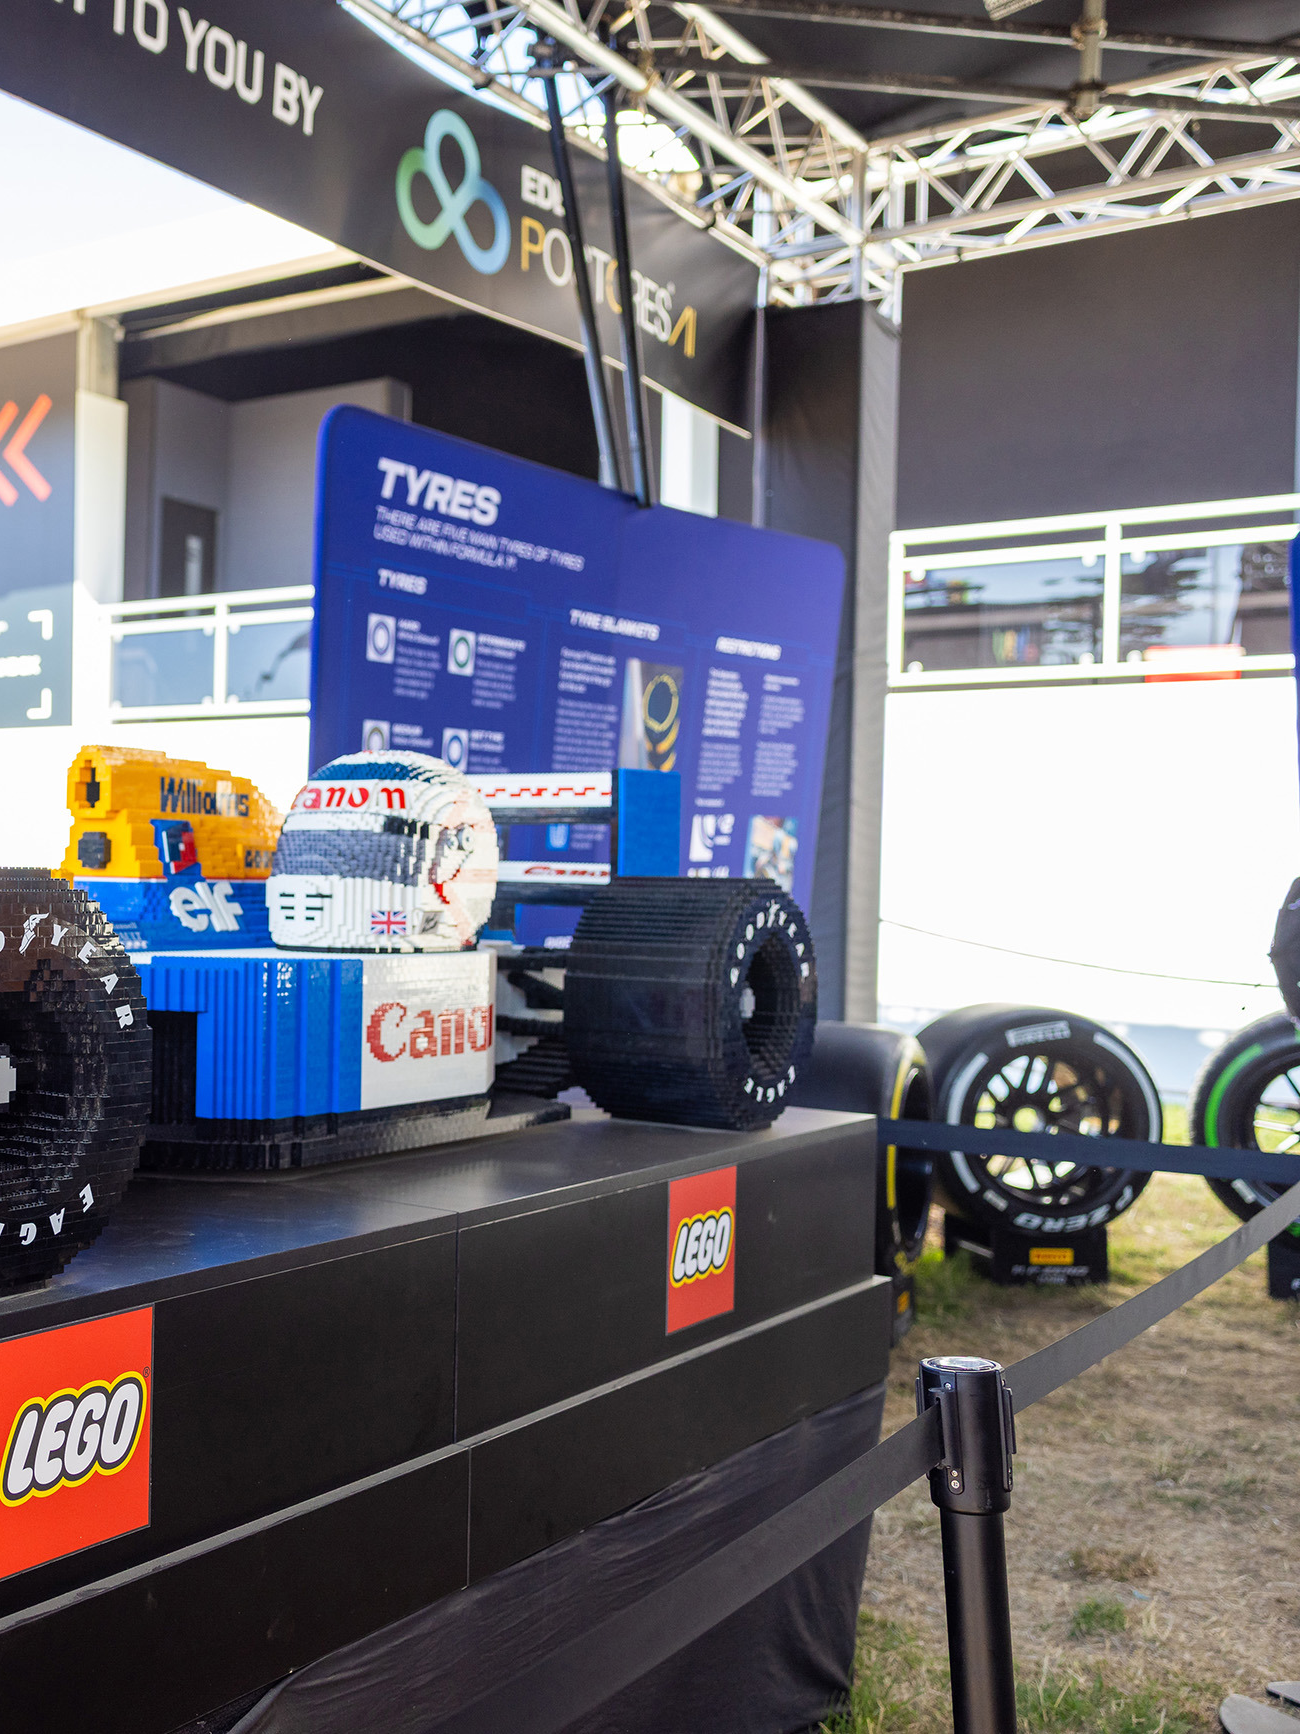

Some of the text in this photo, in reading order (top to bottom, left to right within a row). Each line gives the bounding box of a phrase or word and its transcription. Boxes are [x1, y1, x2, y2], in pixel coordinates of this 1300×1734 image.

[177, 7, 265, 104] YOU
[272, 61, 324, 136] BY
[377, 456, 502, 526] TYRES
[373, 523, 408, 546] USED
[375, 505, 417, 530] THERE
[417, 516, 442, 537] ARE
[378, 568, 428, 595] TYRES
[160, 776, 249, 817] Williams
[169, 881, 243, 932] elf
[674, 1213, 731, 1281] LEGO
[6, 1382, 140, 1495] LEGO
